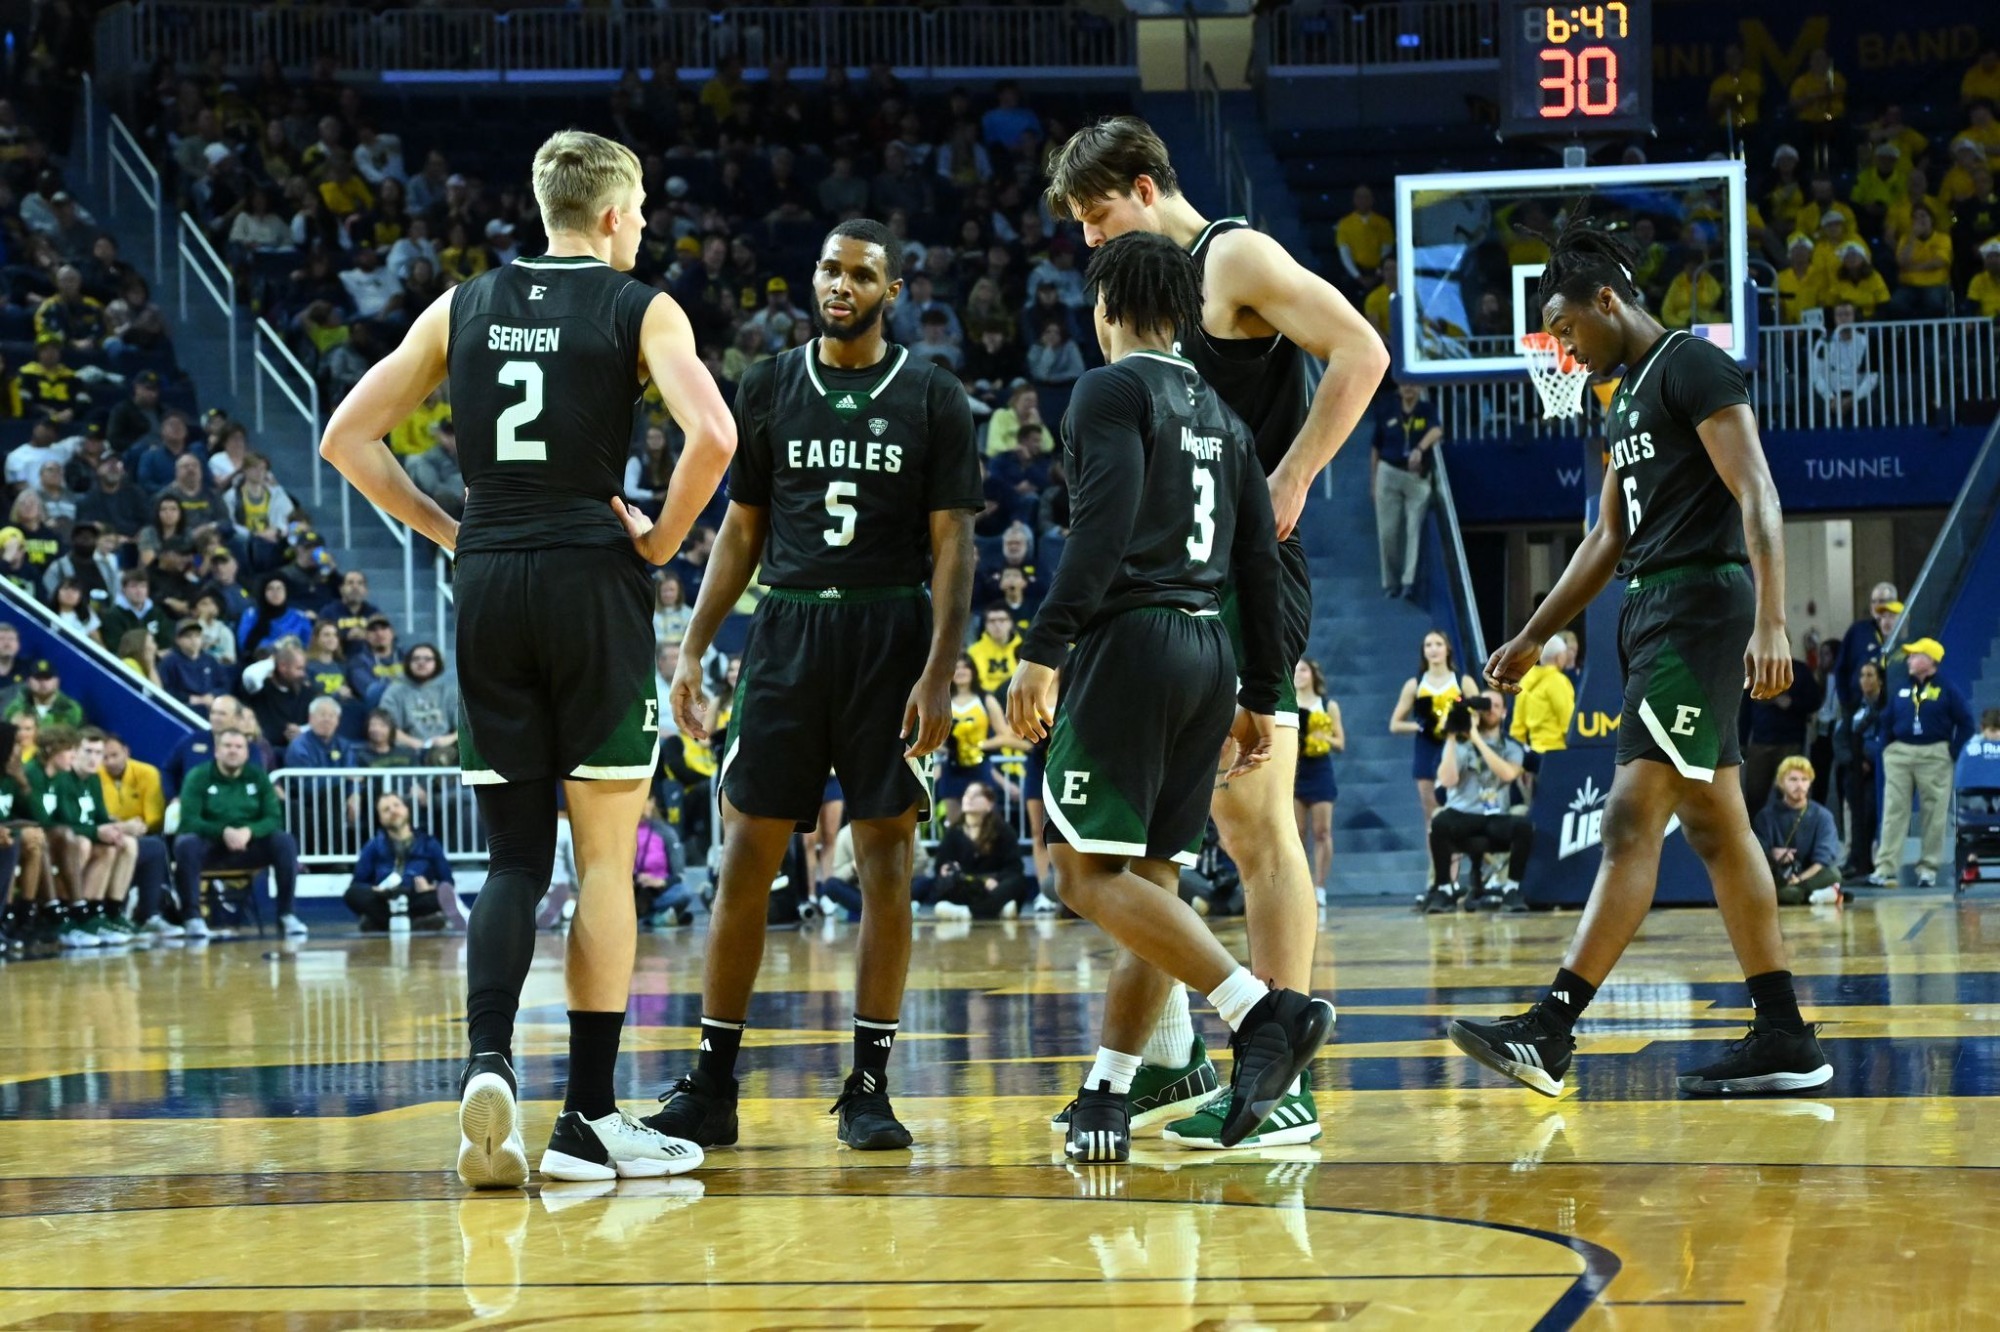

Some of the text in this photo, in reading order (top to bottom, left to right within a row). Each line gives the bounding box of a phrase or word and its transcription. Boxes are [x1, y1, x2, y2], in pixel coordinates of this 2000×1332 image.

[1547, 2, 1628, 44] 6:47
[1857, 23, 1980, 70] BAND
[1539, 46, 1617, 118] 30
[528, 284, 548, 301] E
[487, 324, 561, 353] SERVEN
[496, 360, 548, 462] 2
[787, 438, 903, 474] EAGLES
[1804, 456, 1906, 480] TUNNEL
[823, 480, 858, 547] 5
[1185, 465, 1216, 563] 3
[1669, 703, 1702, 737] E
[1060, 770, 1091, 805] E
